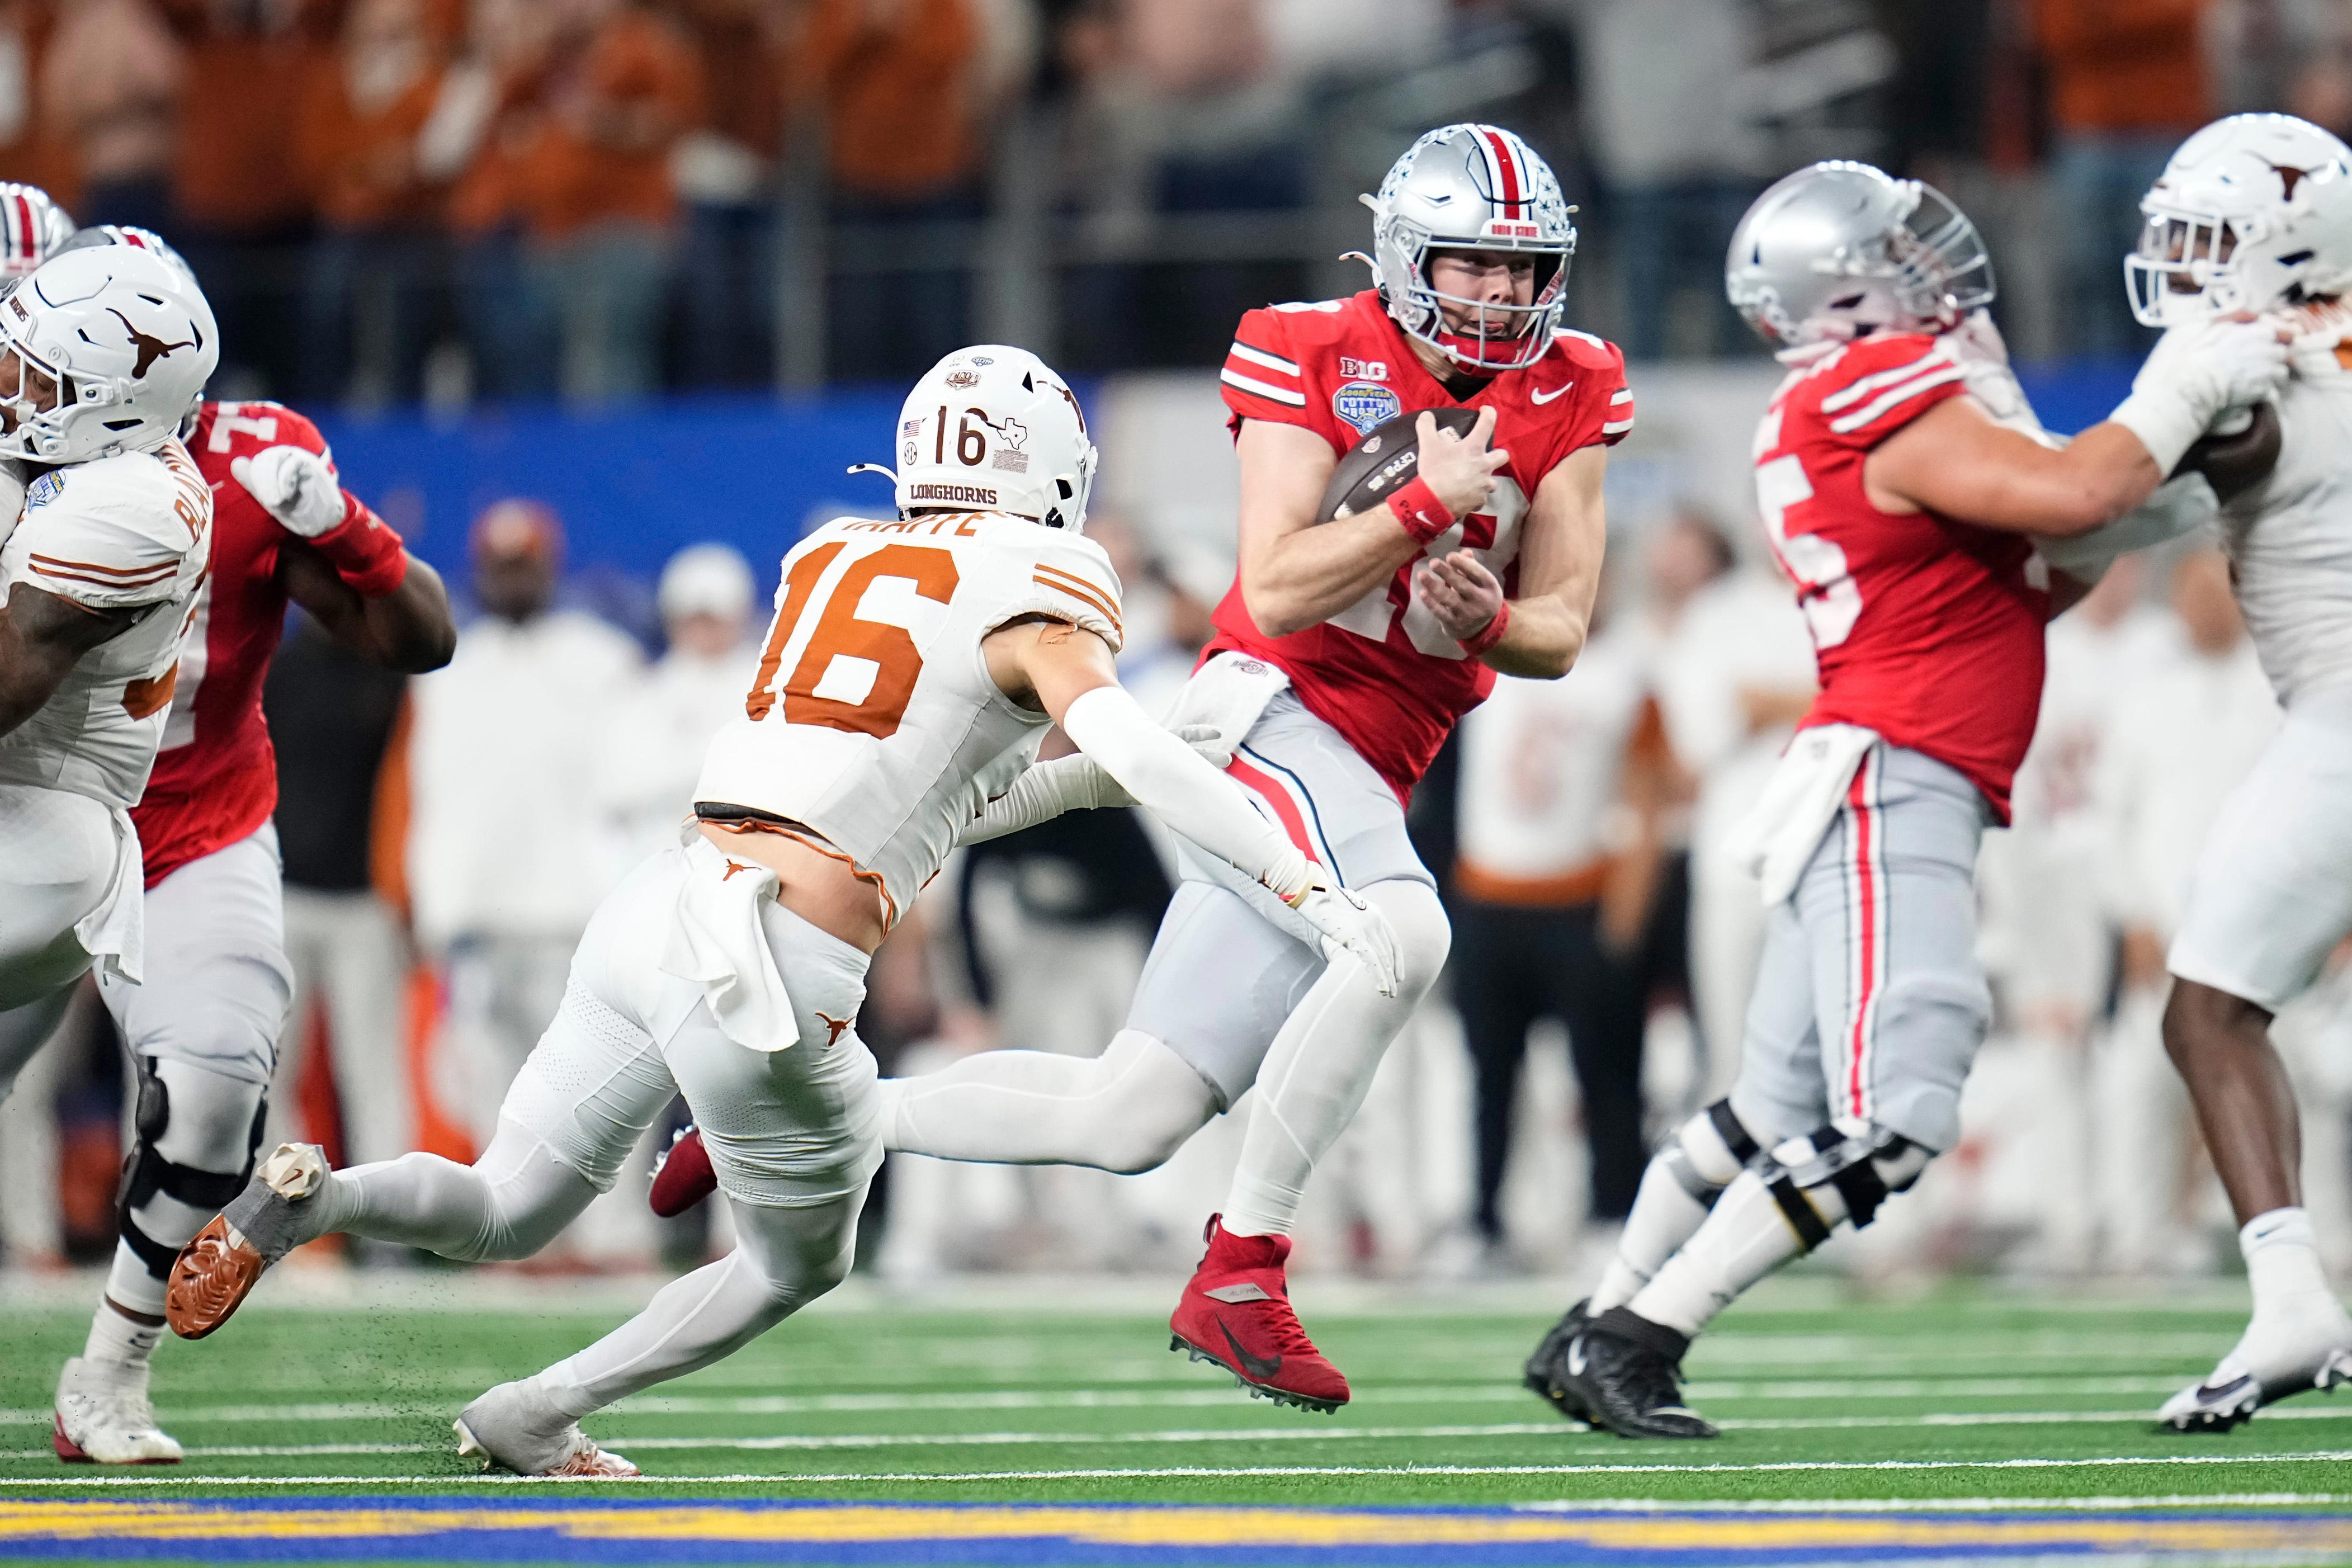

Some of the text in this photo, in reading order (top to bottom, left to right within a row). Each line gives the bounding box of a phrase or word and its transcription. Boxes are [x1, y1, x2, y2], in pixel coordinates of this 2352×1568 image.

[935, 405, 987, 466] 16
[910, 484, 997, 504] LONGHORNS
[745, 541, 960, 740] 16
